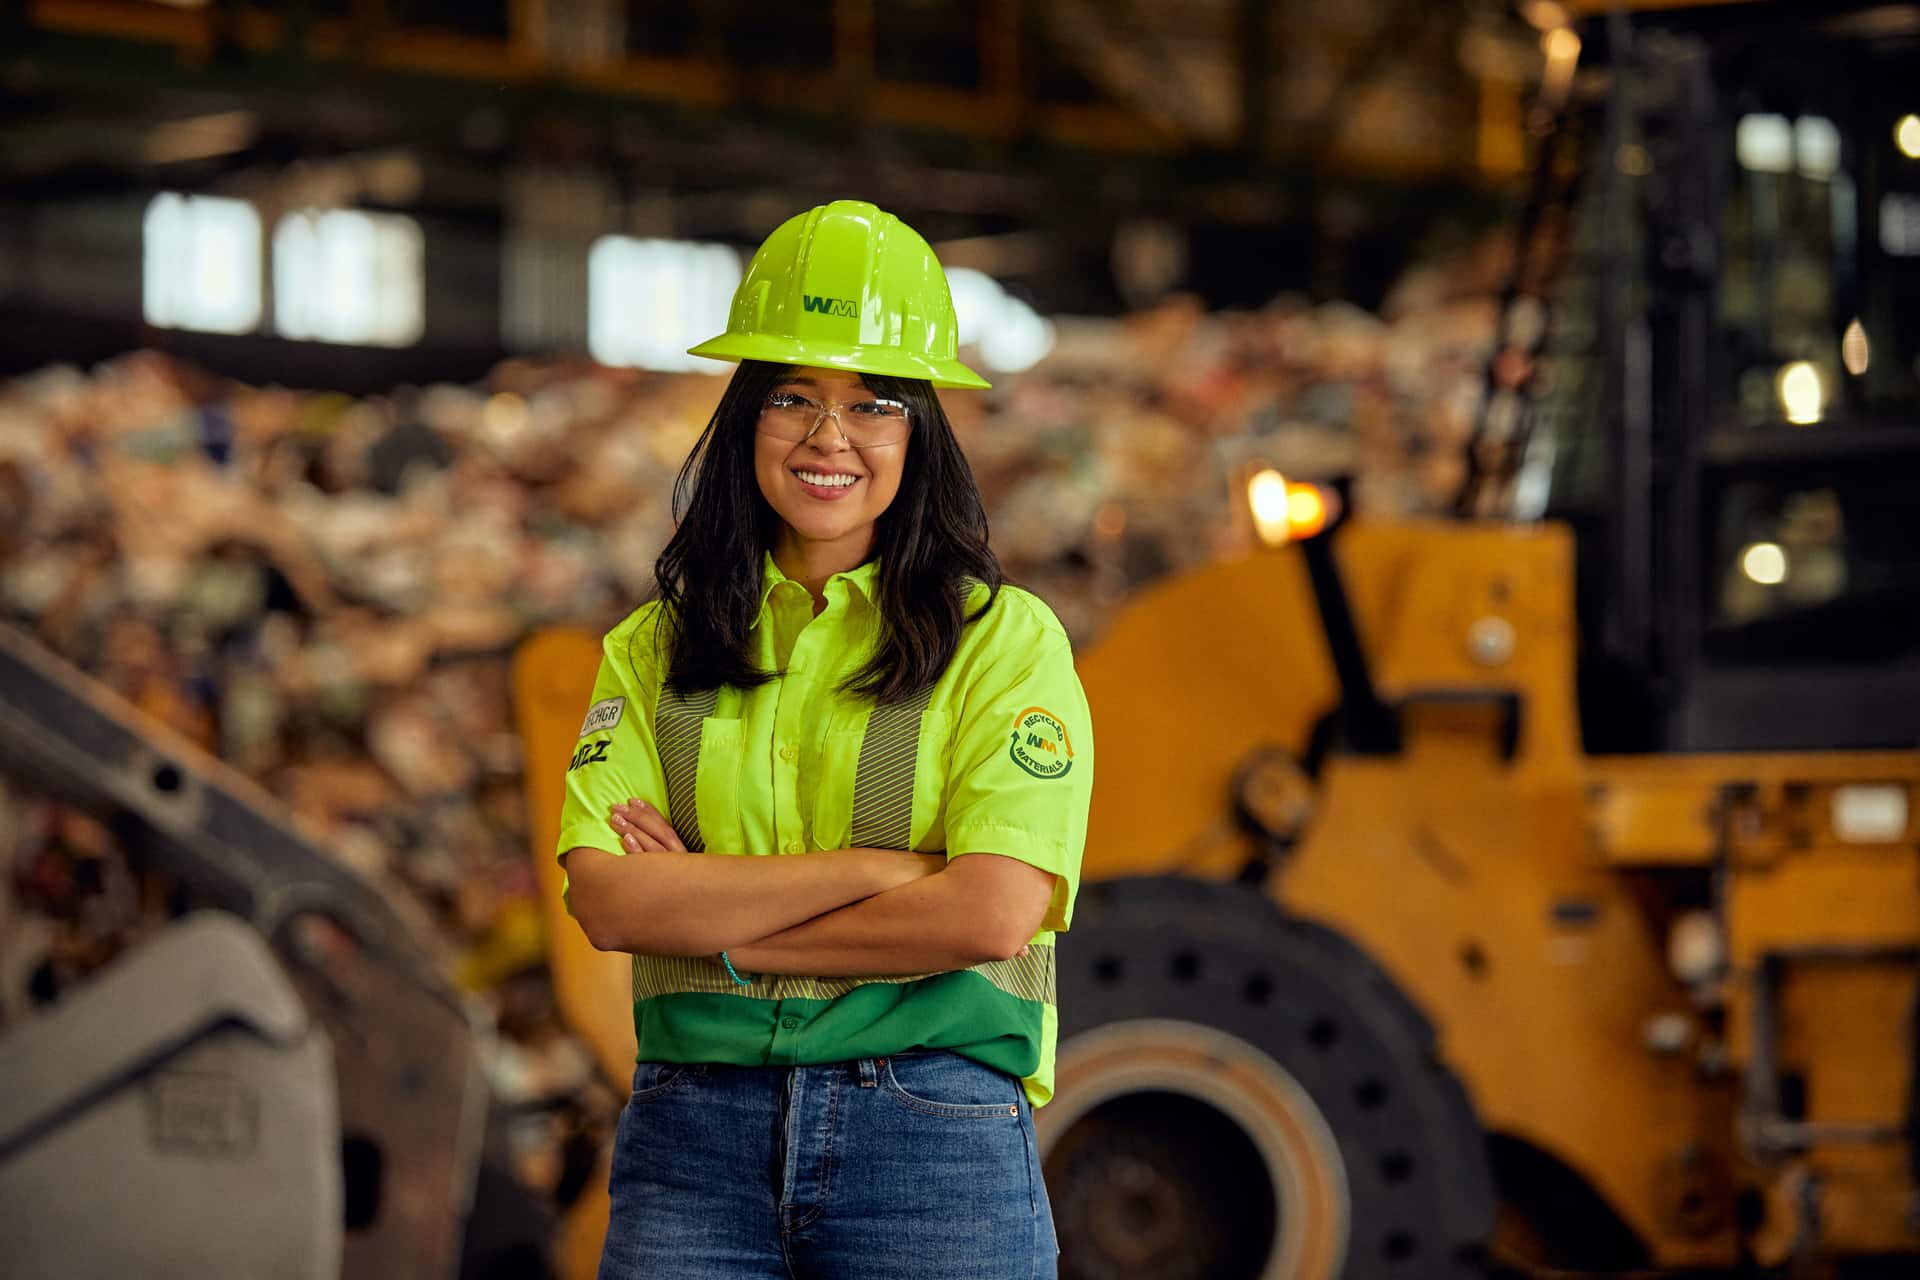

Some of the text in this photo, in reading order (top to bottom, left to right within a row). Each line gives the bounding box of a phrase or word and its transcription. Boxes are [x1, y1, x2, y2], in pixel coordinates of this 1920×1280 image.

[803, 295, 858, 318] WM
[1024, 714, 1063, 742] RECYCLED
[1026, 732, 1057, 755] WM
[1016, 746, 1064, 774] MATERIALS
